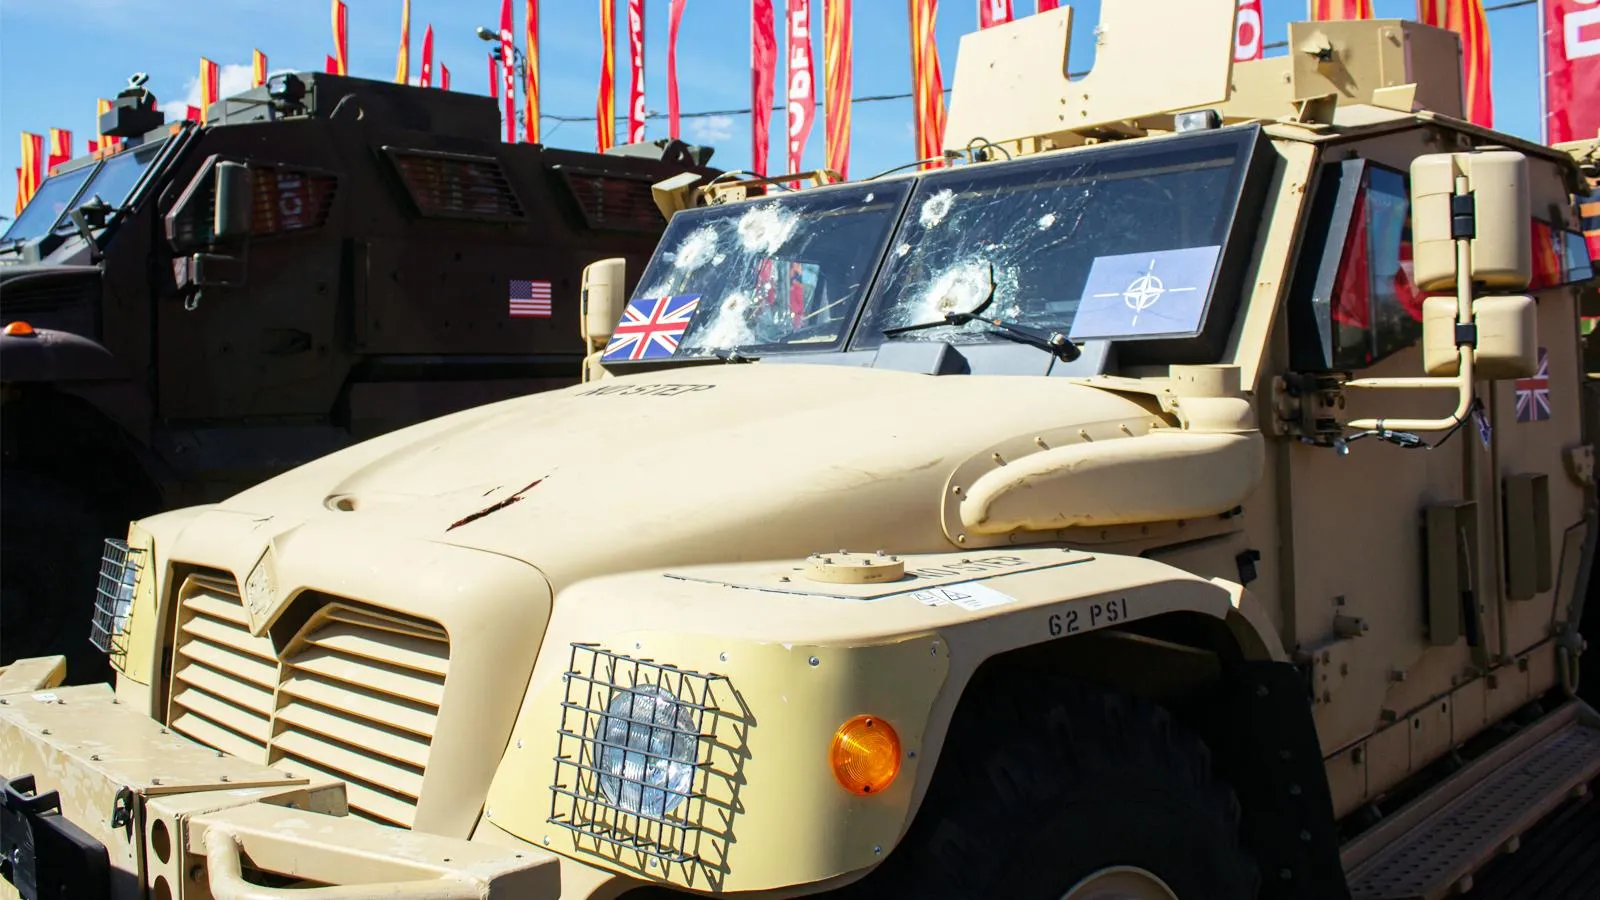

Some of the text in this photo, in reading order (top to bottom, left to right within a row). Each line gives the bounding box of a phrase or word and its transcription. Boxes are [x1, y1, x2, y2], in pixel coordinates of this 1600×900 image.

[574, 384, 717, 396] NO STEP
[942, 556, 1027, 572] STEP
[1049, 598, 1127, 636] 62 PSI
